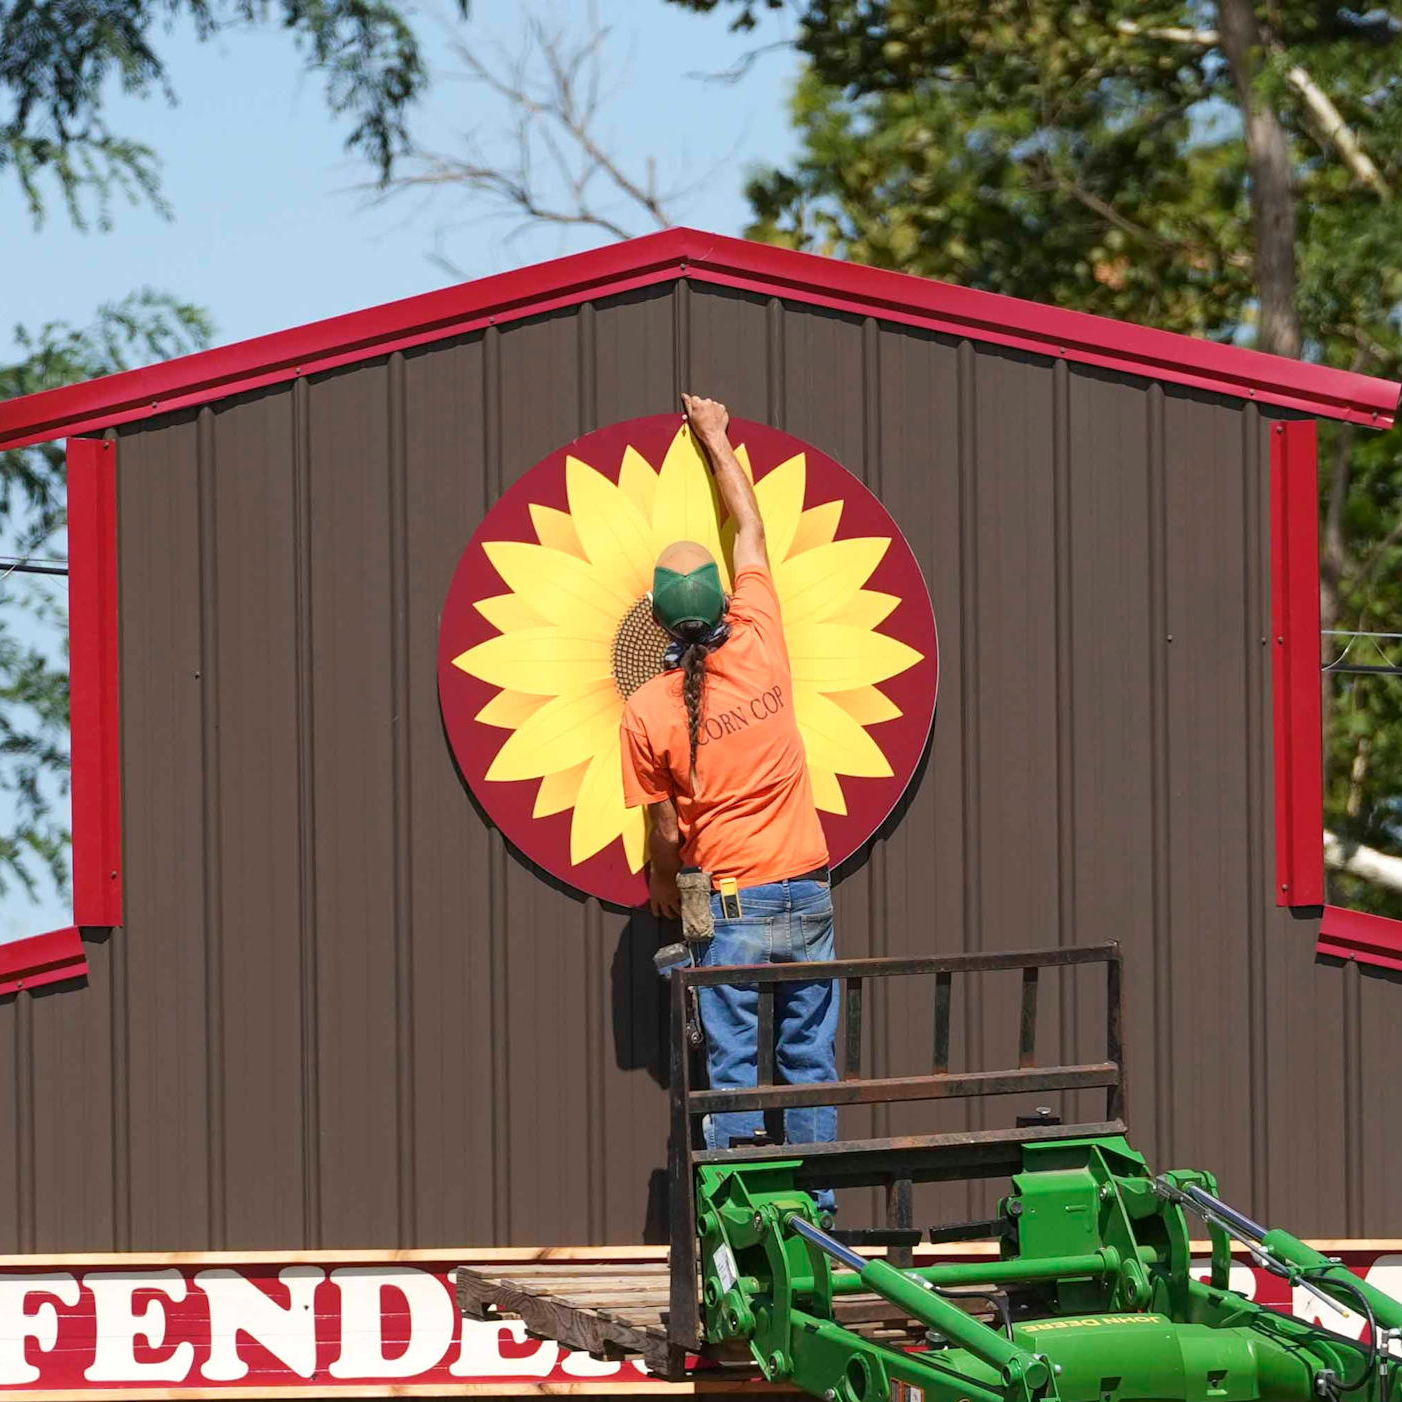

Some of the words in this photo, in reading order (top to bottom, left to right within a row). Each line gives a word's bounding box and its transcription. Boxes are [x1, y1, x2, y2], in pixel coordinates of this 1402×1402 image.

[750, 685, 785, 721] COP
[1020, 1318, 1100, 1333] DEERE
[1101, 1316, 1161, 1326] JOHN
